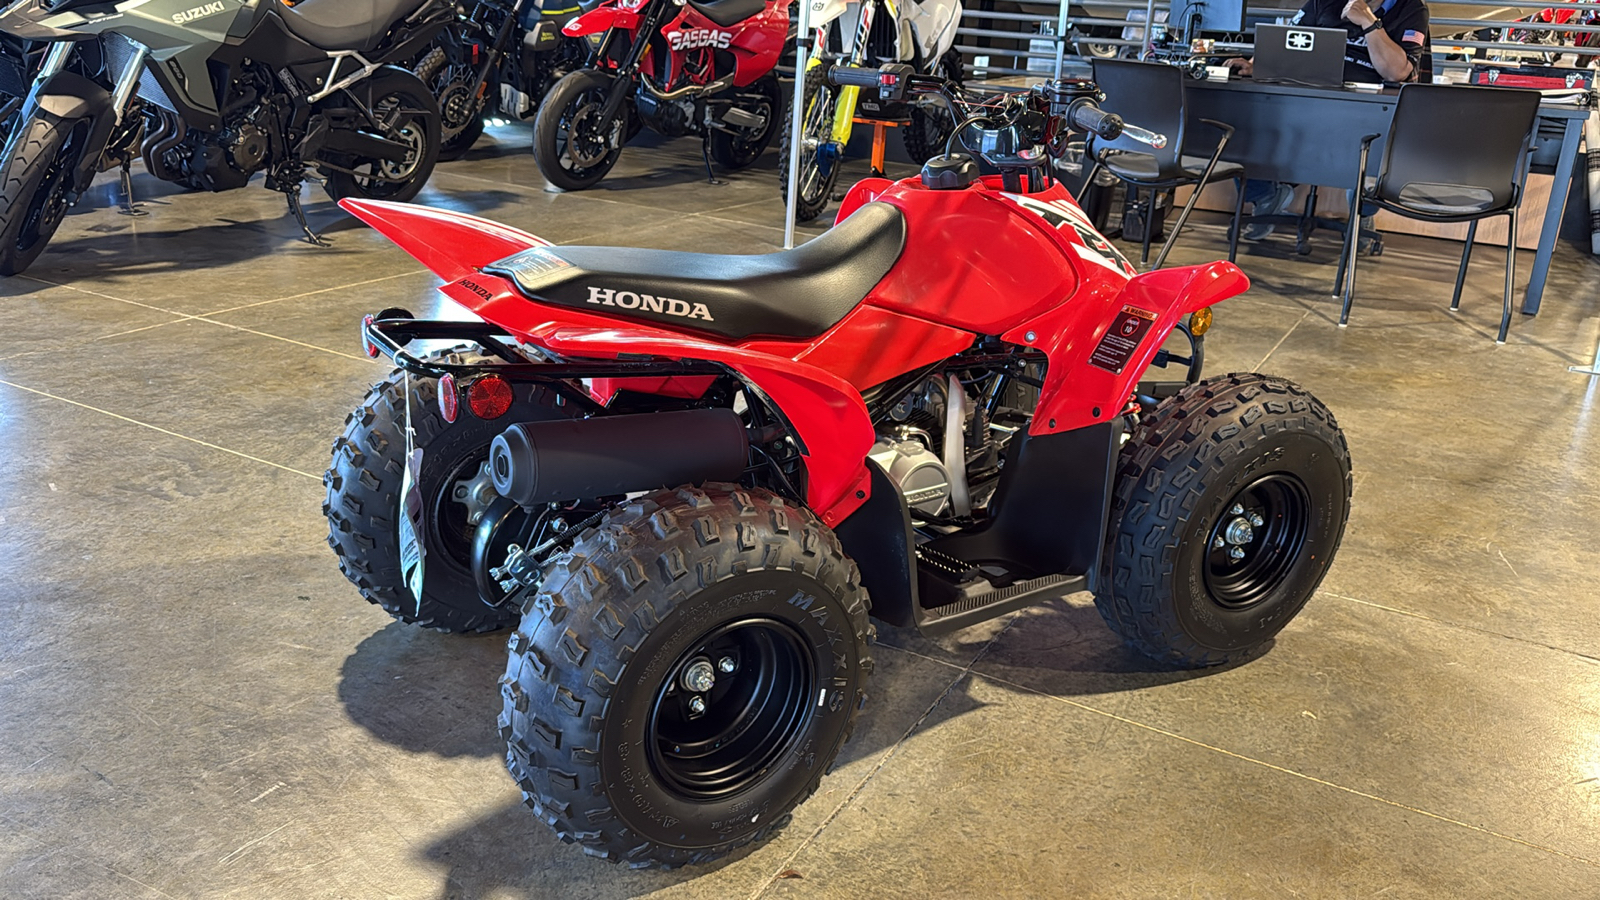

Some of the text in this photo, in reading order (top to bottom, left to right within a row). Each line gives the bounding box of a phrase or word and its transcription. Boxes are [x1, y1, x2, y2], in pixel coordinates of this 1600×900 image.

[172, 1, 225, 24] SUZUKI
[667, 29, 732, 51] GASGAS
[459, 279, 493, 301] HONDA
[586, 286, 714, 321] HONDA
[787, 588, 849, 712] MAXXIS
